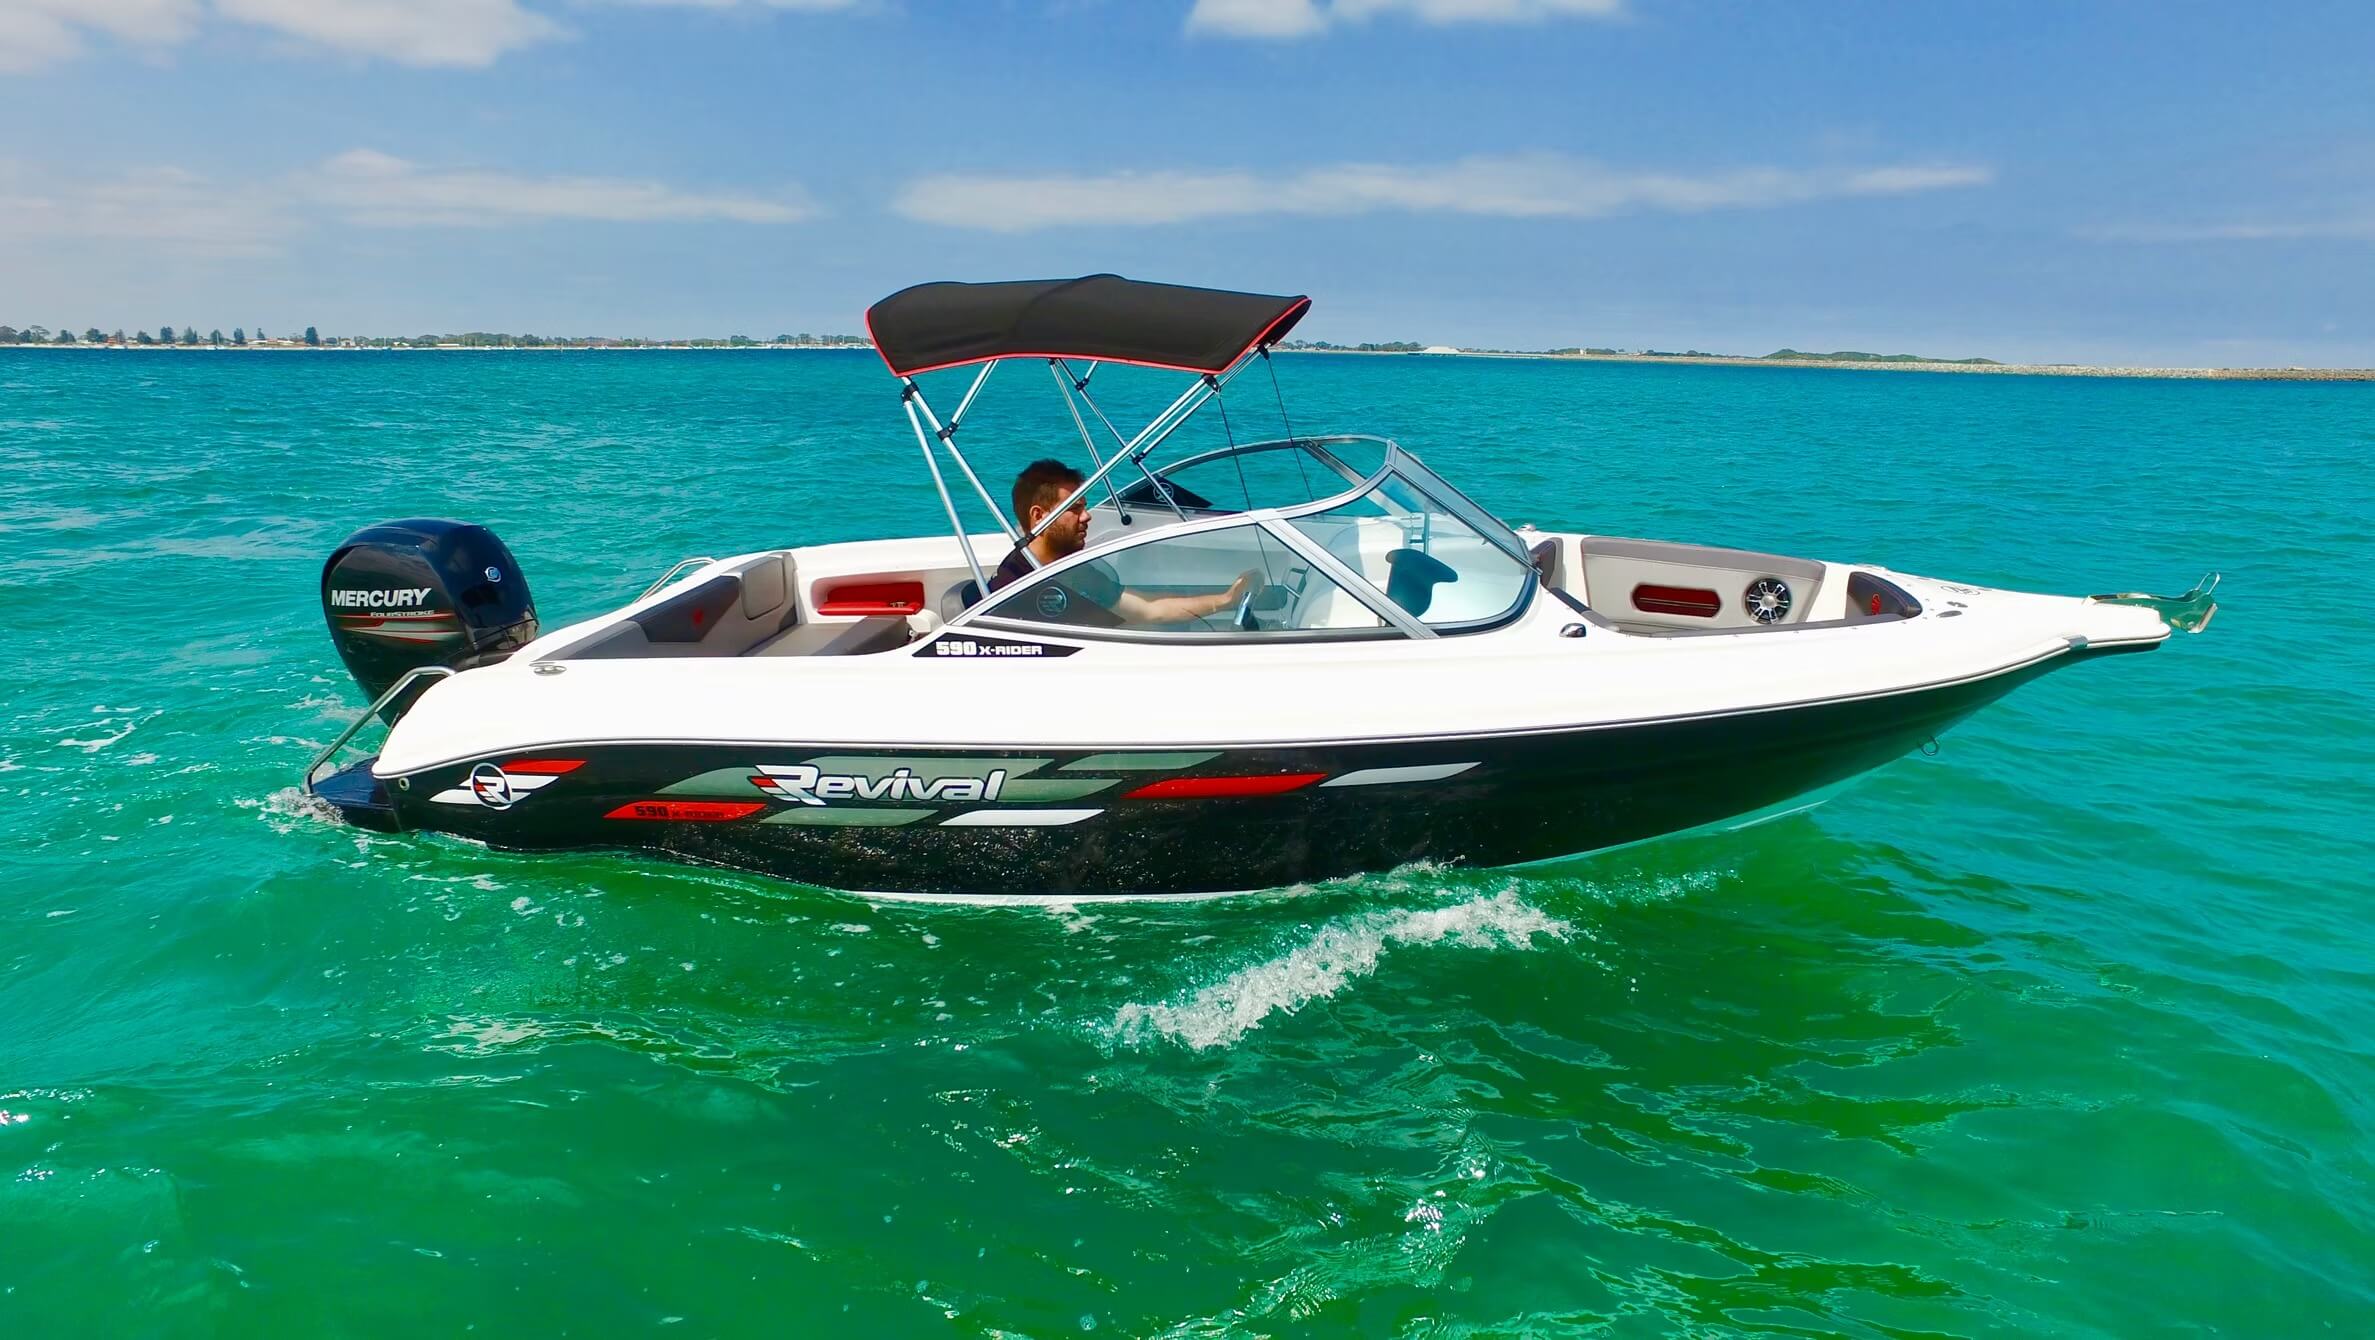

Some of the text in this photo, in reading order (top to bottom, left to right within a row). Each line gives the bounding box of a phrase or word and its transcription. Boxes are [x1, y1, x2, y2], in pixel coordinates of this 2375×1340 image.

[331, 587, 432, 607] MERCURY
[935, 641, 1042, 656] 590 X-RIDER
[752, 764, 1006, 805] Revival
